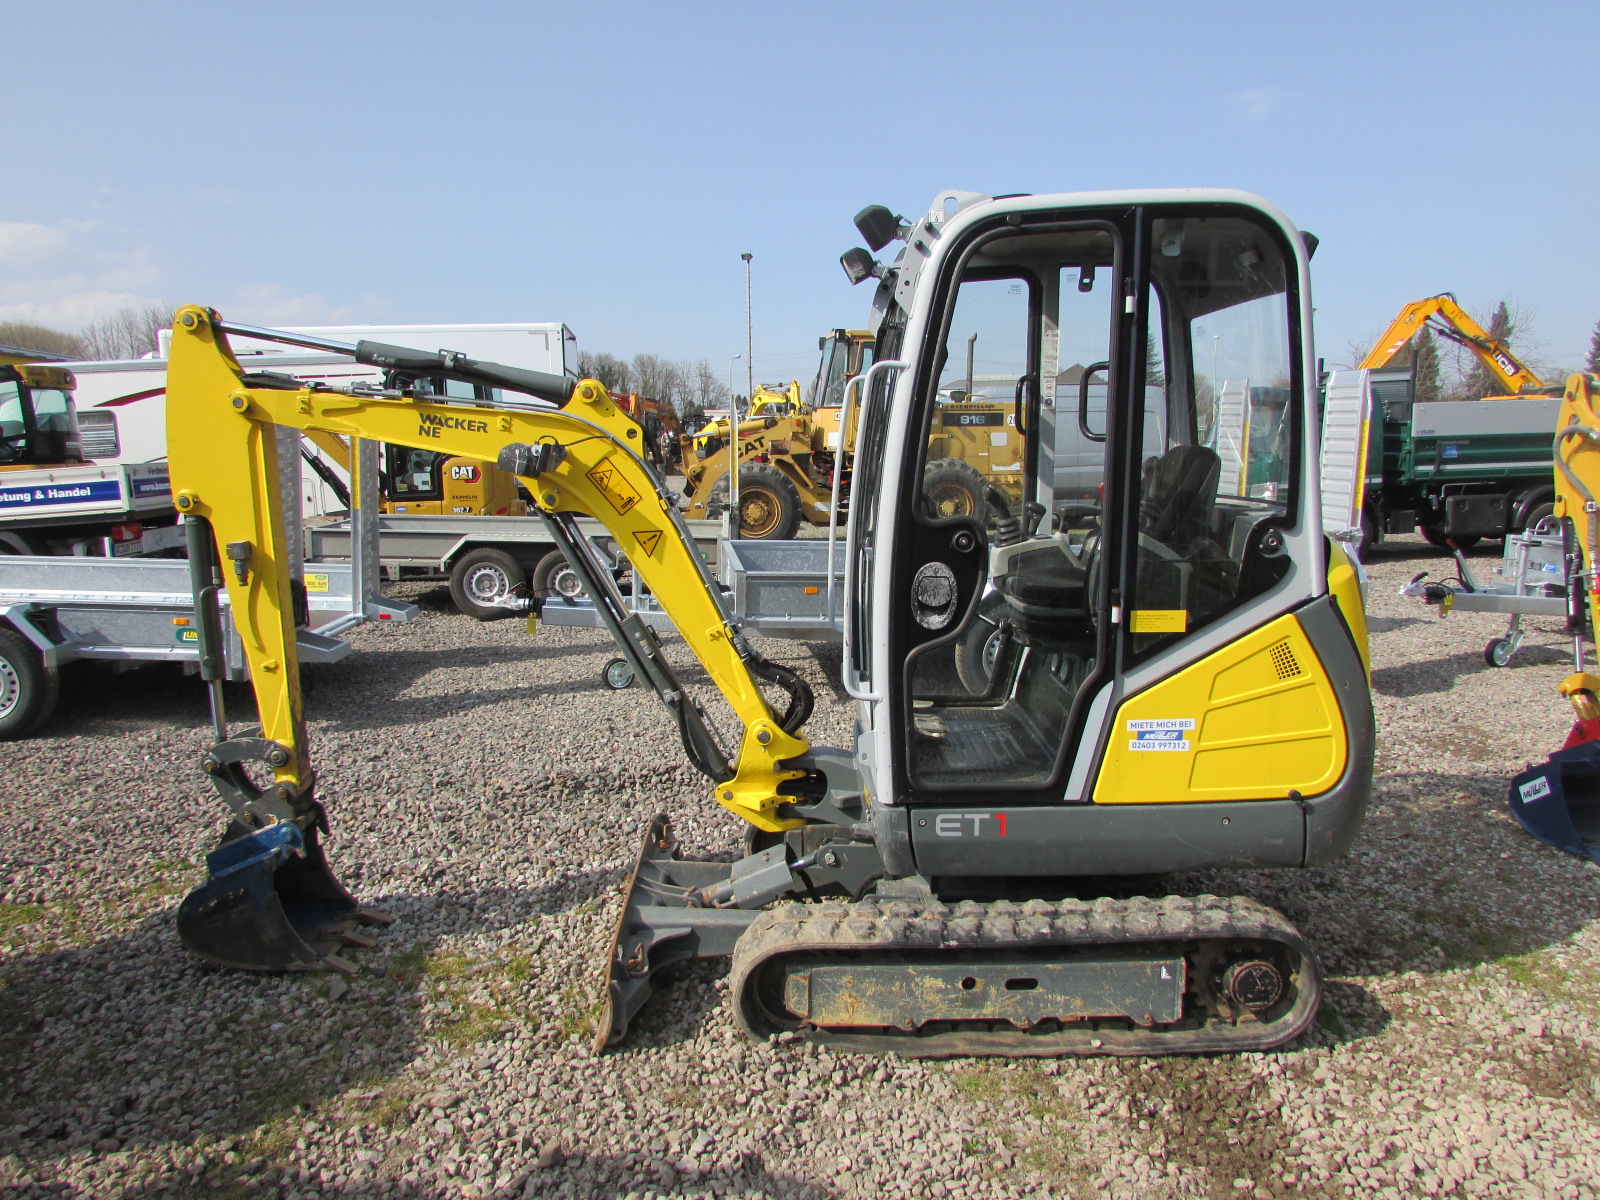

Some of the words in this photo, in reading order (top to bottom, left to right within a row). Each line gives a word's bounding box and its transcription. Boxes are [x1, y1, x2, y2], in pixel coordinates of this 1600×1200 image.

[1492, 353, 1515, 376] JCB
[419, 413, 488, 433] WACKER
[960, 415, 985, 424] 916
[419, 425, 441, 438] NE
[451, 466, 474, 480] CAT
[34, 490, 44, 499] &
[48, 487, 91, 499] Handel
[1179, 720, 1192, 728] BEI
